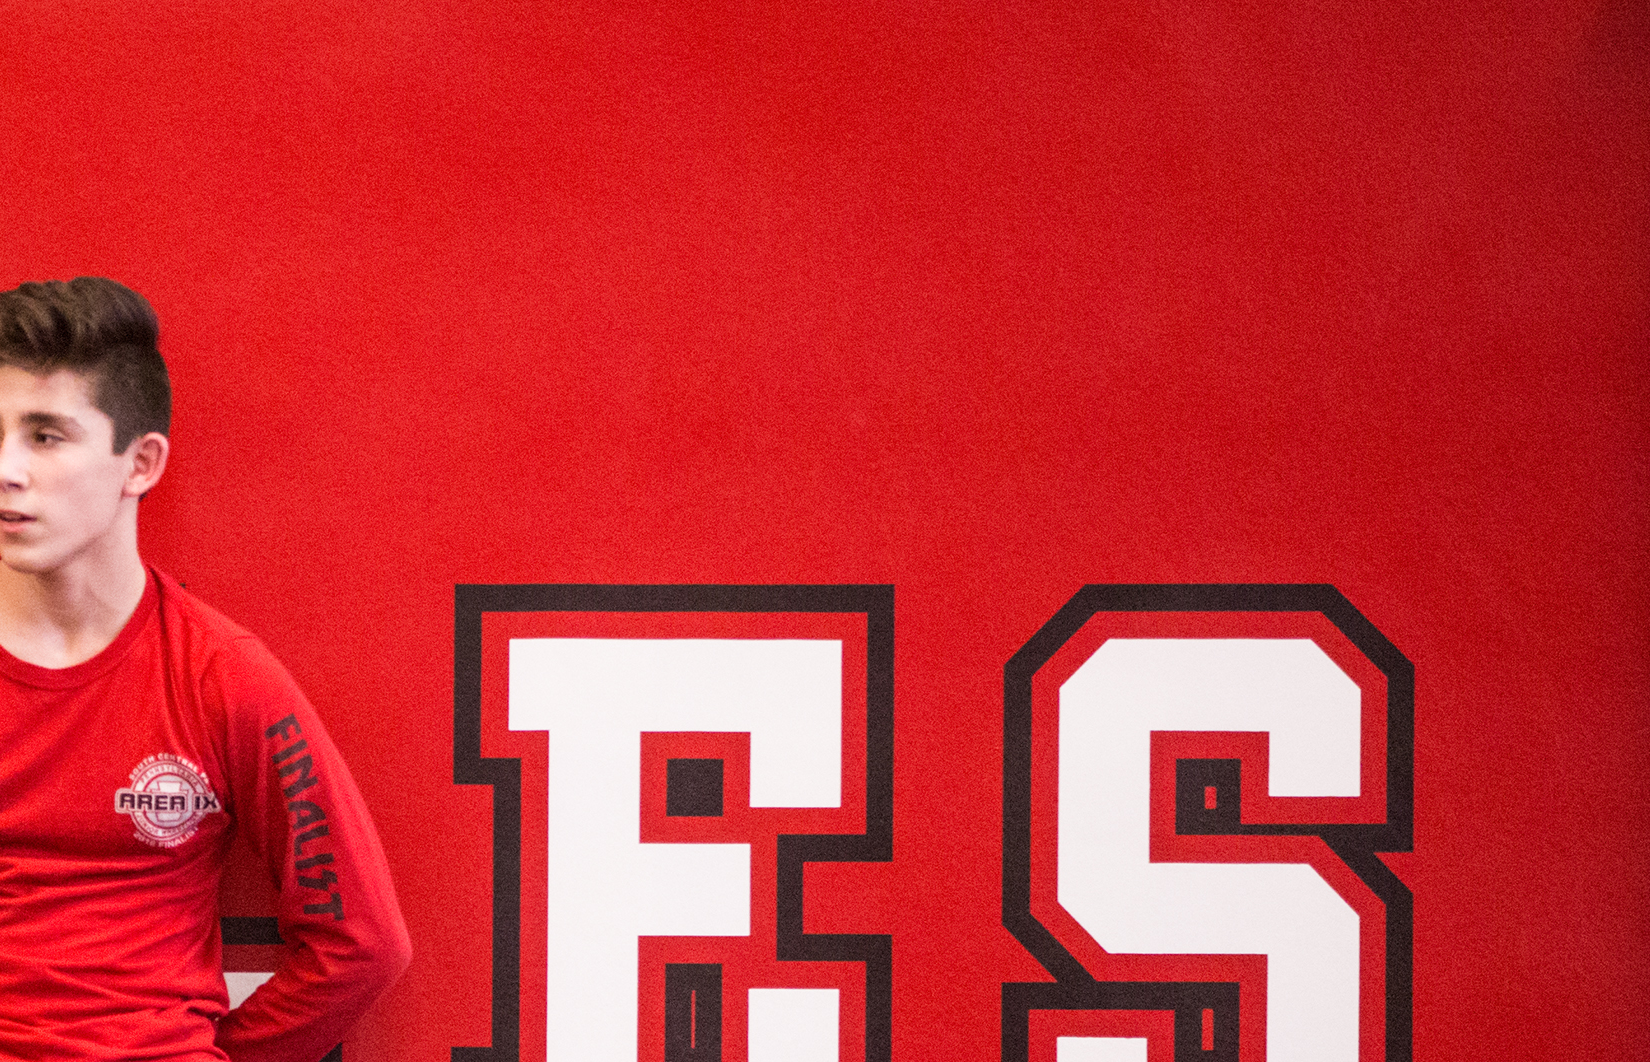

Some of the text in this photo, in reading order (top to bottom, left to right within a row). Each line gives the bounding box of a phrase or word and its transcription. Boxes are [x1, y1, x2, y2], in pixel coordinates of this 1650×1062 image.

[129, 755, 155, 780] SOUTH
[157, 753, 198, 773] CENTRAL
[119, 793, 218, 811] AREA IX
[265, 713, 345, 921] FINALIST
